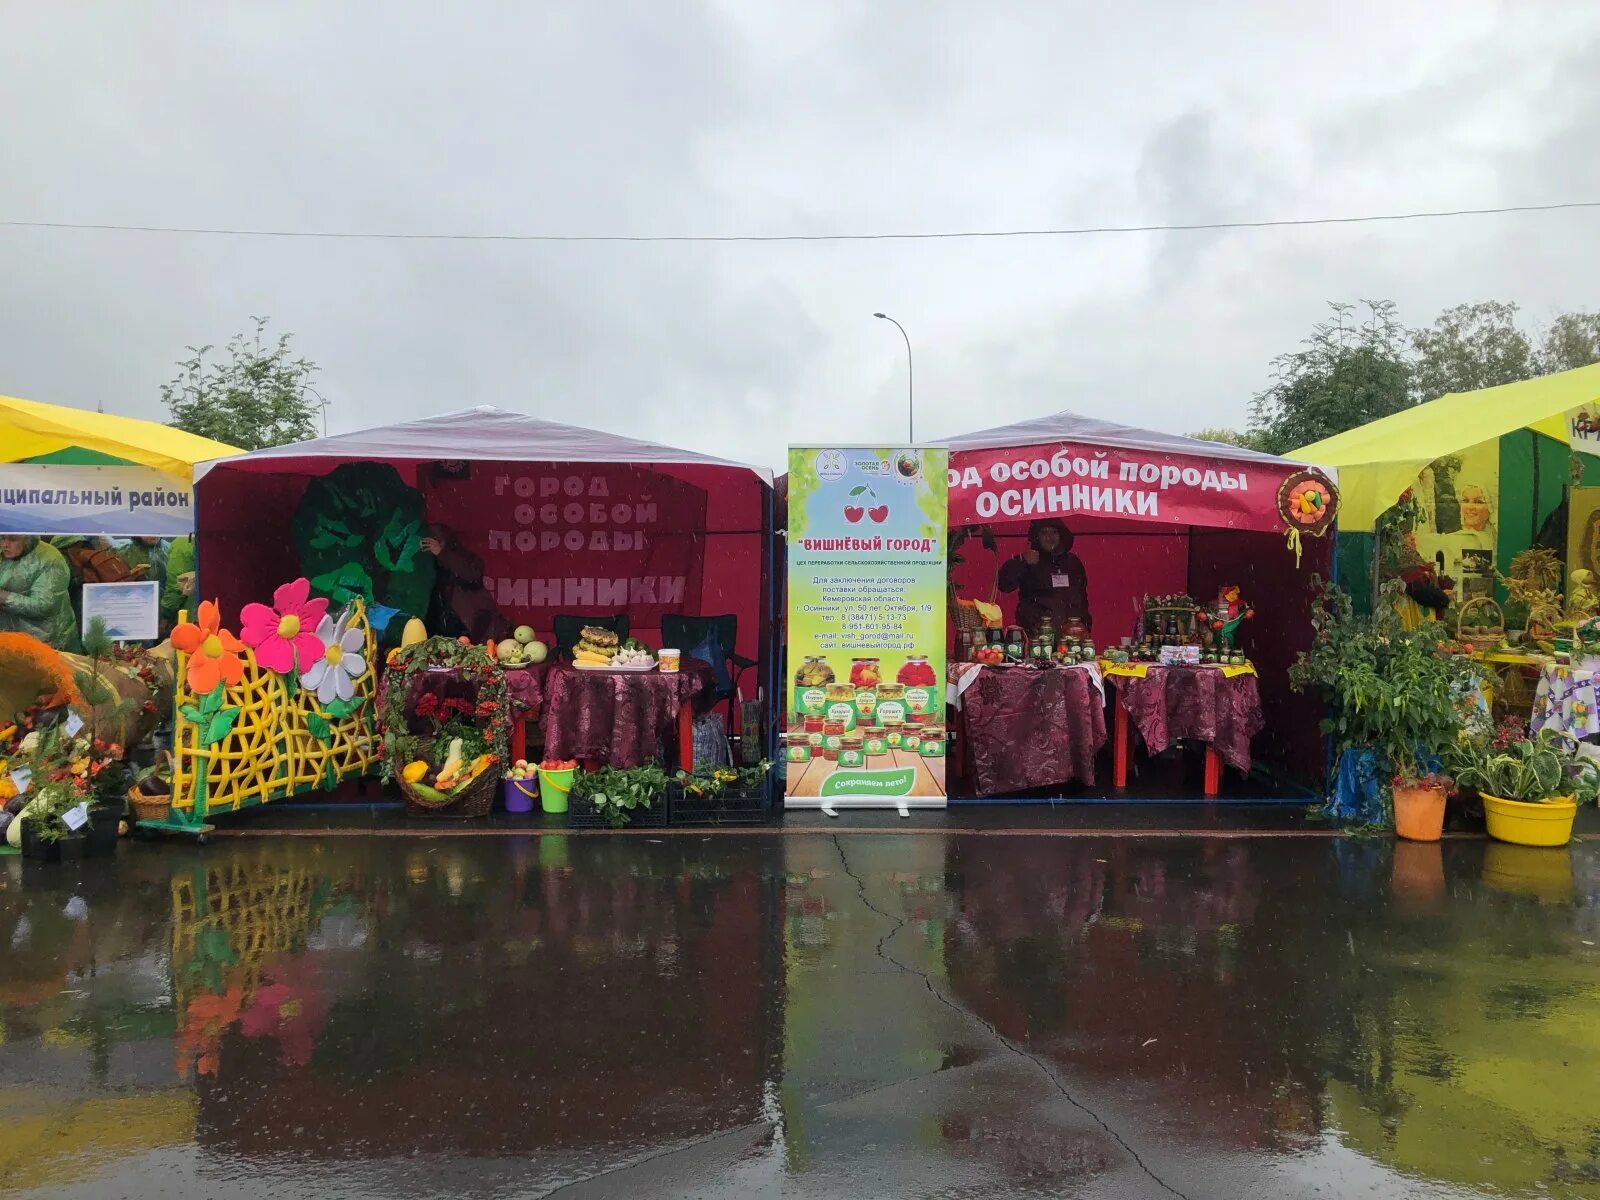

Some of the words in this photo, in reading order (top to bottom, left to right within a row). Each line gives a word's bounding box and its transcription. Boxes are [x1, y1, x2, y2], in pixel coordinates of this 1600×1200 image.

[990, 450, 1110, 482] особой
[1119, 461, 1248, 490] породы
[495, 475, 609, 497] ГОРОД
[0, 486, 122, 506] ципальный
[129, 487, 189, 512] район
[514, 494, 657, 525] ОСОБОЙ
[976, 483, 1158, 518] ОСИННИКИ
[489, 529, 644, 551] ПОРОДЫ
[848, 613, 877, 621] (38471)
[834, 778, 883, 789] Сохраняем
[885, 775, 907, 787] лето!
